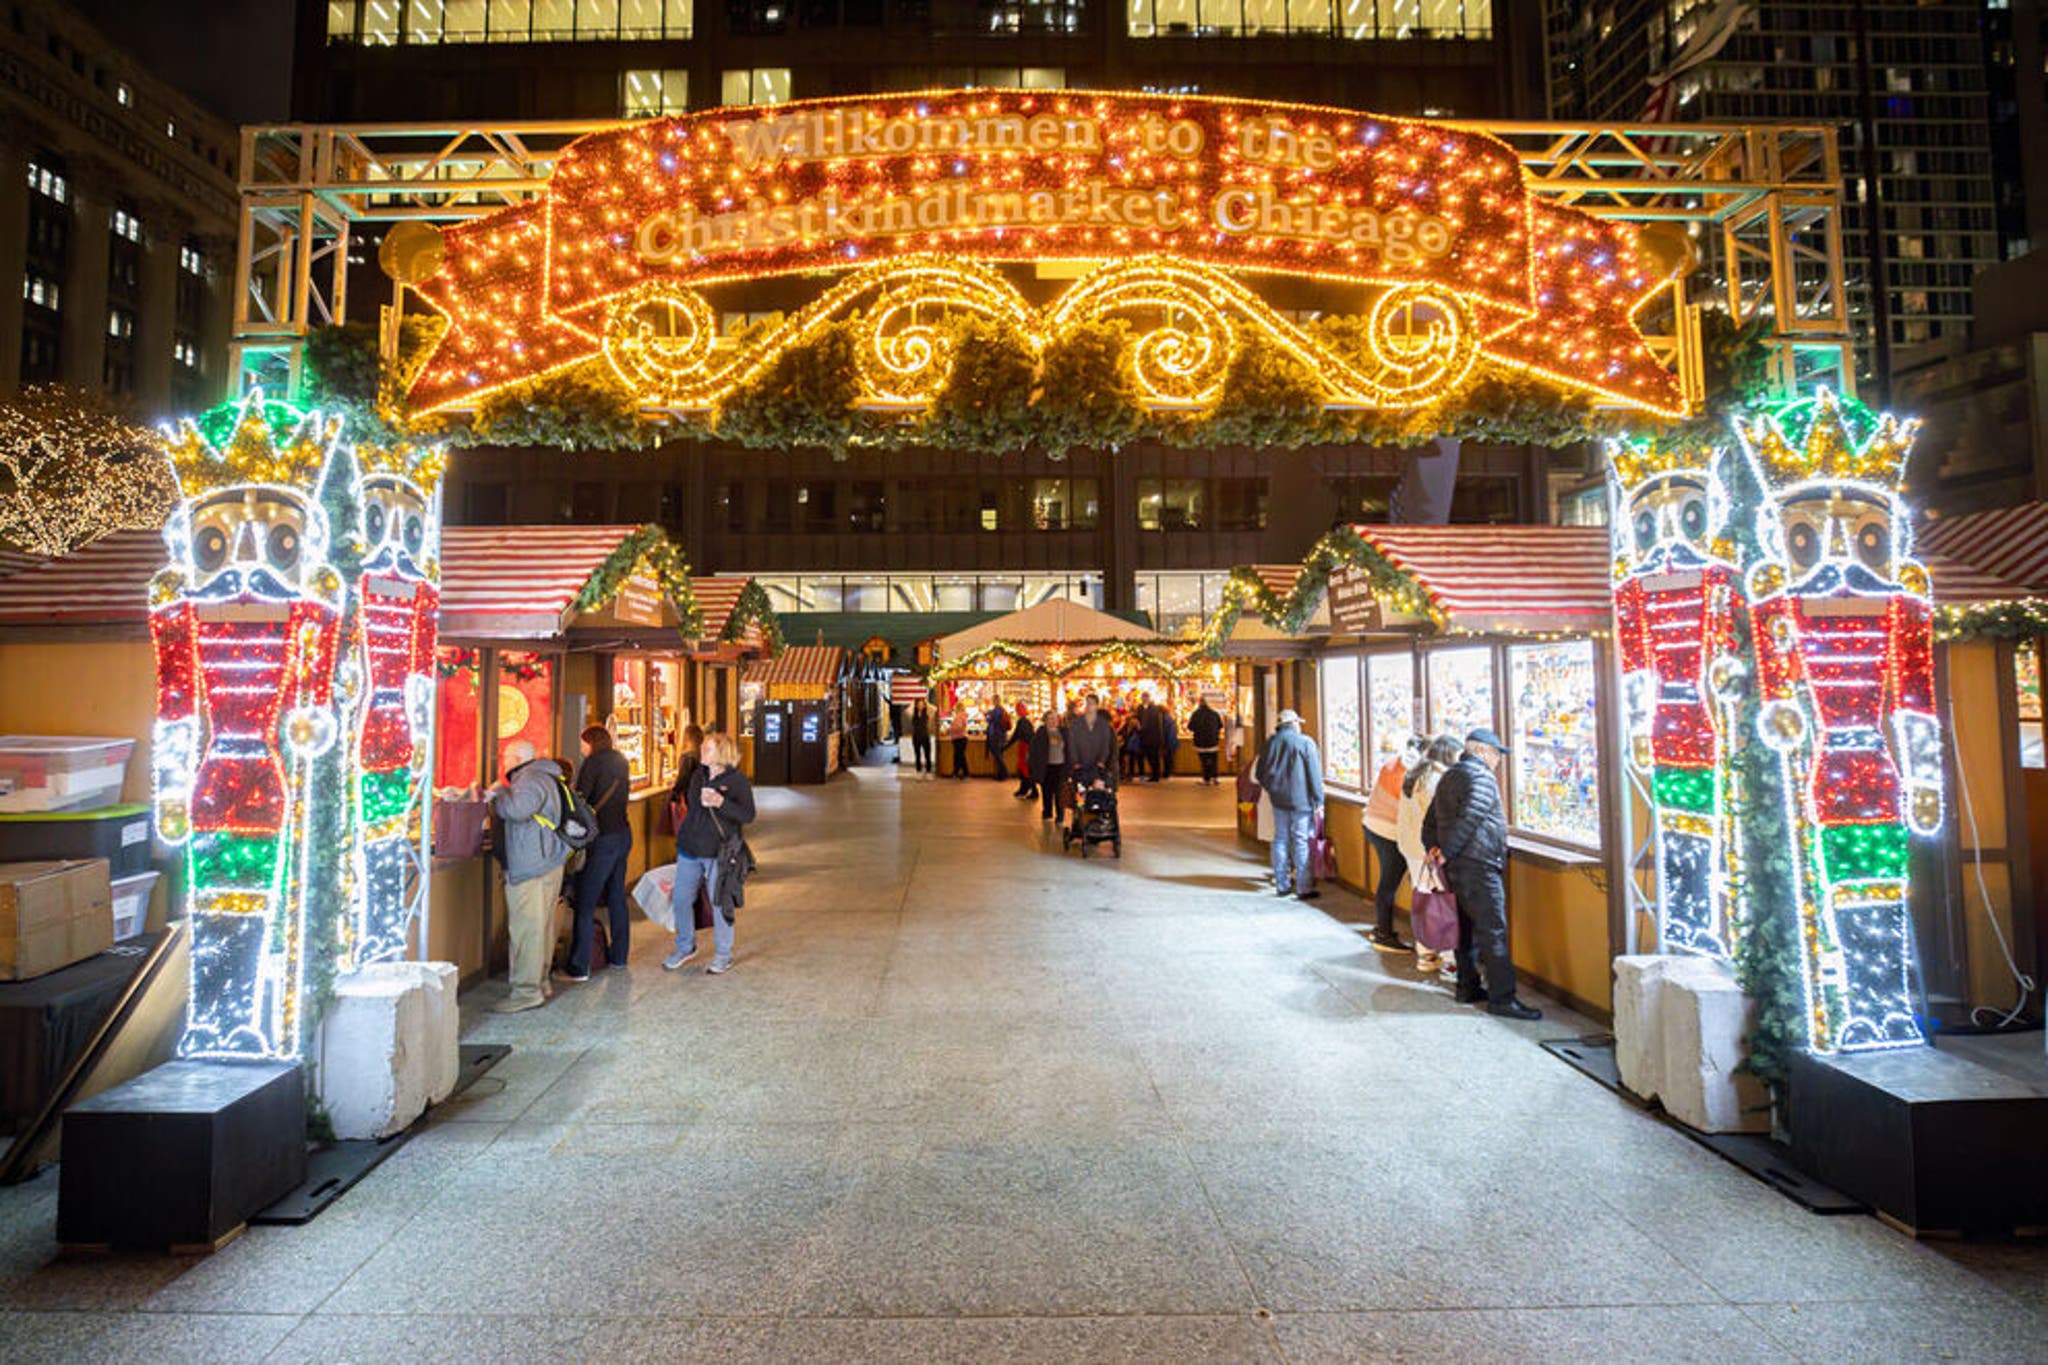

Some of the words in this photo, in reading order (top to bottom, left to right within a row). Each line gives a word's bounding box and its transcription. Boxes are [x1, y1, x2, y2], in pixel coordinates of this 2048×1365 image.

[731, 110, 1097, 164] Willkommen
[1144, 115, 1200, 154] to
[1241, 117, 1332, 168] the
[639, 182, 1180, 260] Christkindlmarket
[1215, 184, 1447, 262] Chicago
